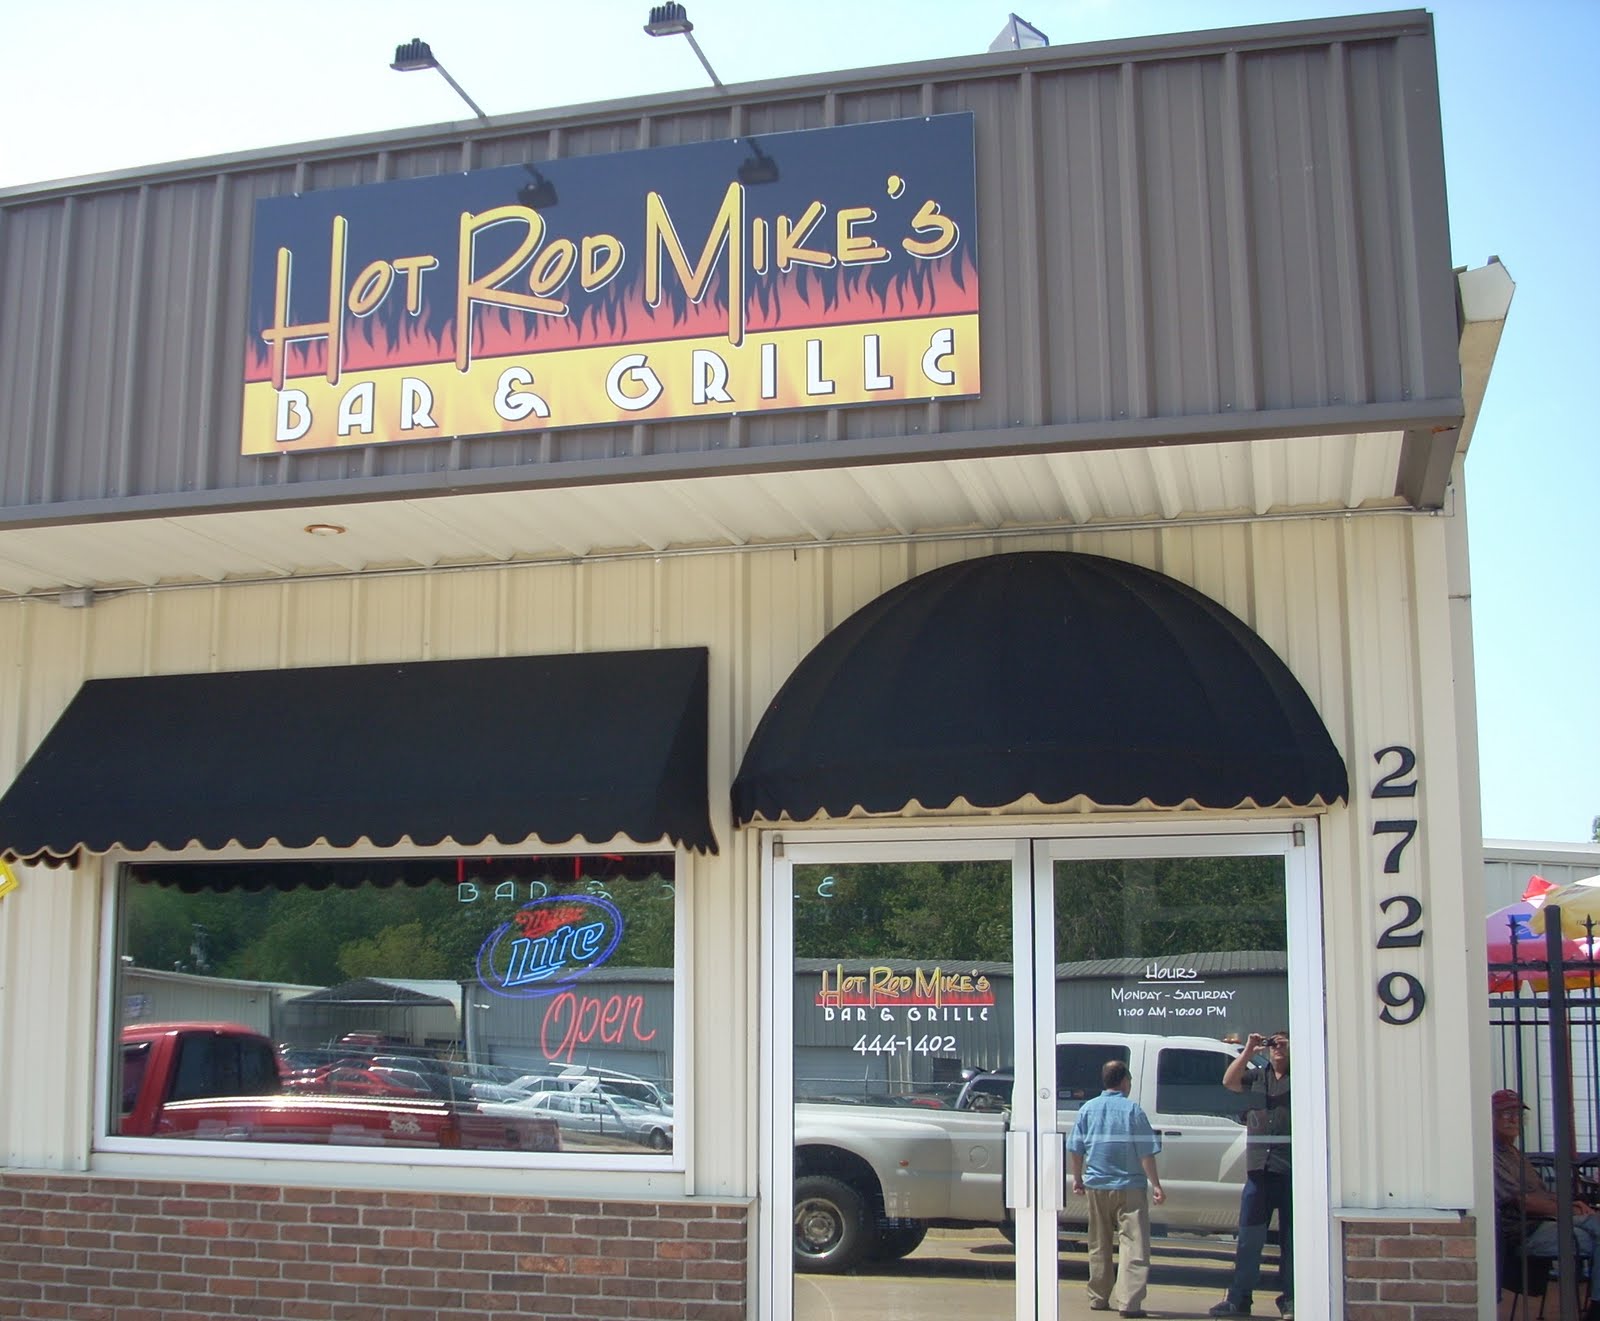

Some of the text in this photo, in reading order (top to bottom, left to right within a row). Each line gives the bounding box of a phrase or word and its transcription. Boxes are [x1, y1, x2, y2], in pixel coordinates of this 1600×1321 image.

[261, 181, 960, 391] HOT ROD MIKE'S
[275, 327, 955, 442] BAR & GRILLE
[1371, 745, 1426, 1026] 2729
[502, 922, 605, 987] Lite
[1145, 962, 1198, 980] HOURS
[819, 963, 991, 1009] HOT ROD MIKE'S
[1111, 987, 1163, 1001] MONDAY
[1173, 989, 1236, 1001] SATURDAY
[540, 992, 657, 1064] Open
[824, 1007, 989, 1021] BAR & GRILLE
[1117, 1007, 1144, 1017] 11:00
[1206, 1006, 1226, 1017] PM
[852, 1034, 957, 1056] 444-1402
